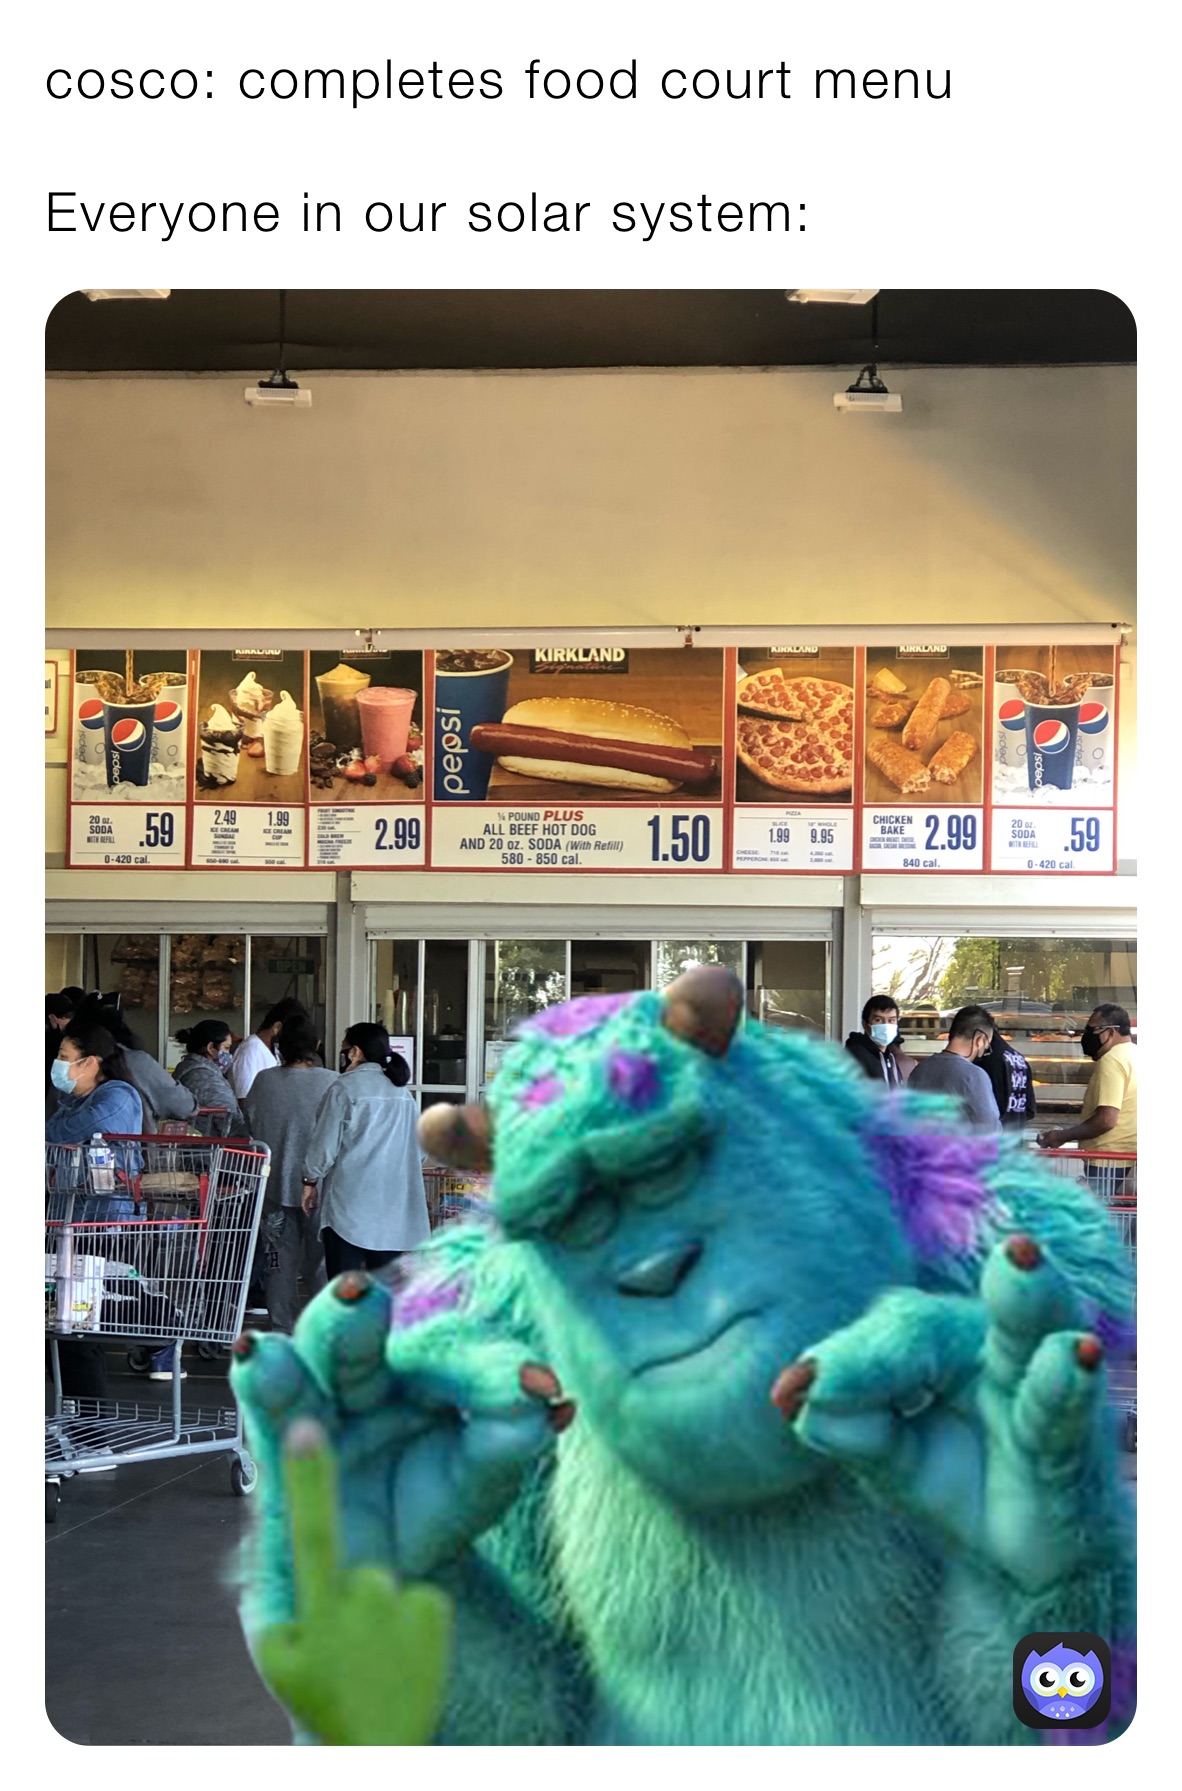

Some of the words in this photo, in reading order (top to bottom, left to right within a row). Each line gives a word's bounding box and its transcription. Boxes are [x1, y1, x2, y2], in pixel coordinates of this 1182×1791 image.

[535, 648, 625, 662] KIRKLAND
[535, 661, 625, 675] Signature
[436, 707, 471, 794] pepsi
[89, 815, 100, 824] 20
[214, 810, 237, 825] 2.49
[268, 811, 289, 826] 1.99
[508, 812, 540, 821] POUND
[543, 810, 584, 821] PLUS
[873, 815, 913, 824] CHICKEN
[89, 825, 113, 834] SODA
[139, 812, 174, 847] .59
[483, 824, 505, 835] ALL
[509, 824, 538, 835] BEEF
[543, 824, 567, 835] HOT
[571, 824, 596, 836] DOG
[881, 826, 905, 834] BAKE
[1011, 819, 1022, 828] 20
[375, 818, 420, 850] 2.99
[647, 814, 710, 862] 1.50
[769, 828, 790, 843] 1.99
[810, 828, 834, 843] 9.95
[925, 815, 976, 850] 2.99
[1011, 829, 1036, 838] SODA
[1064, 817, 1100, 852] .59
[460, 838, 485, 850] AND
[489, 838, 503, 850] 20
[507, 841, 523, 850] oz.
[528, 838, 562, 850] SODA
[566, 841, 591, 852] (With
[594, 841, 624, 852] Refill)
[134, 855, 150, 864] cal.
[501, 853, 524, 864] 580
[536, 853, 558, 864] 850
[561, 853, 582, 864] cal.
[903, 859, 920, 867] 840
[923, 859, 940, 867] cal.
[1059, 860, 1075, 868] cal.
